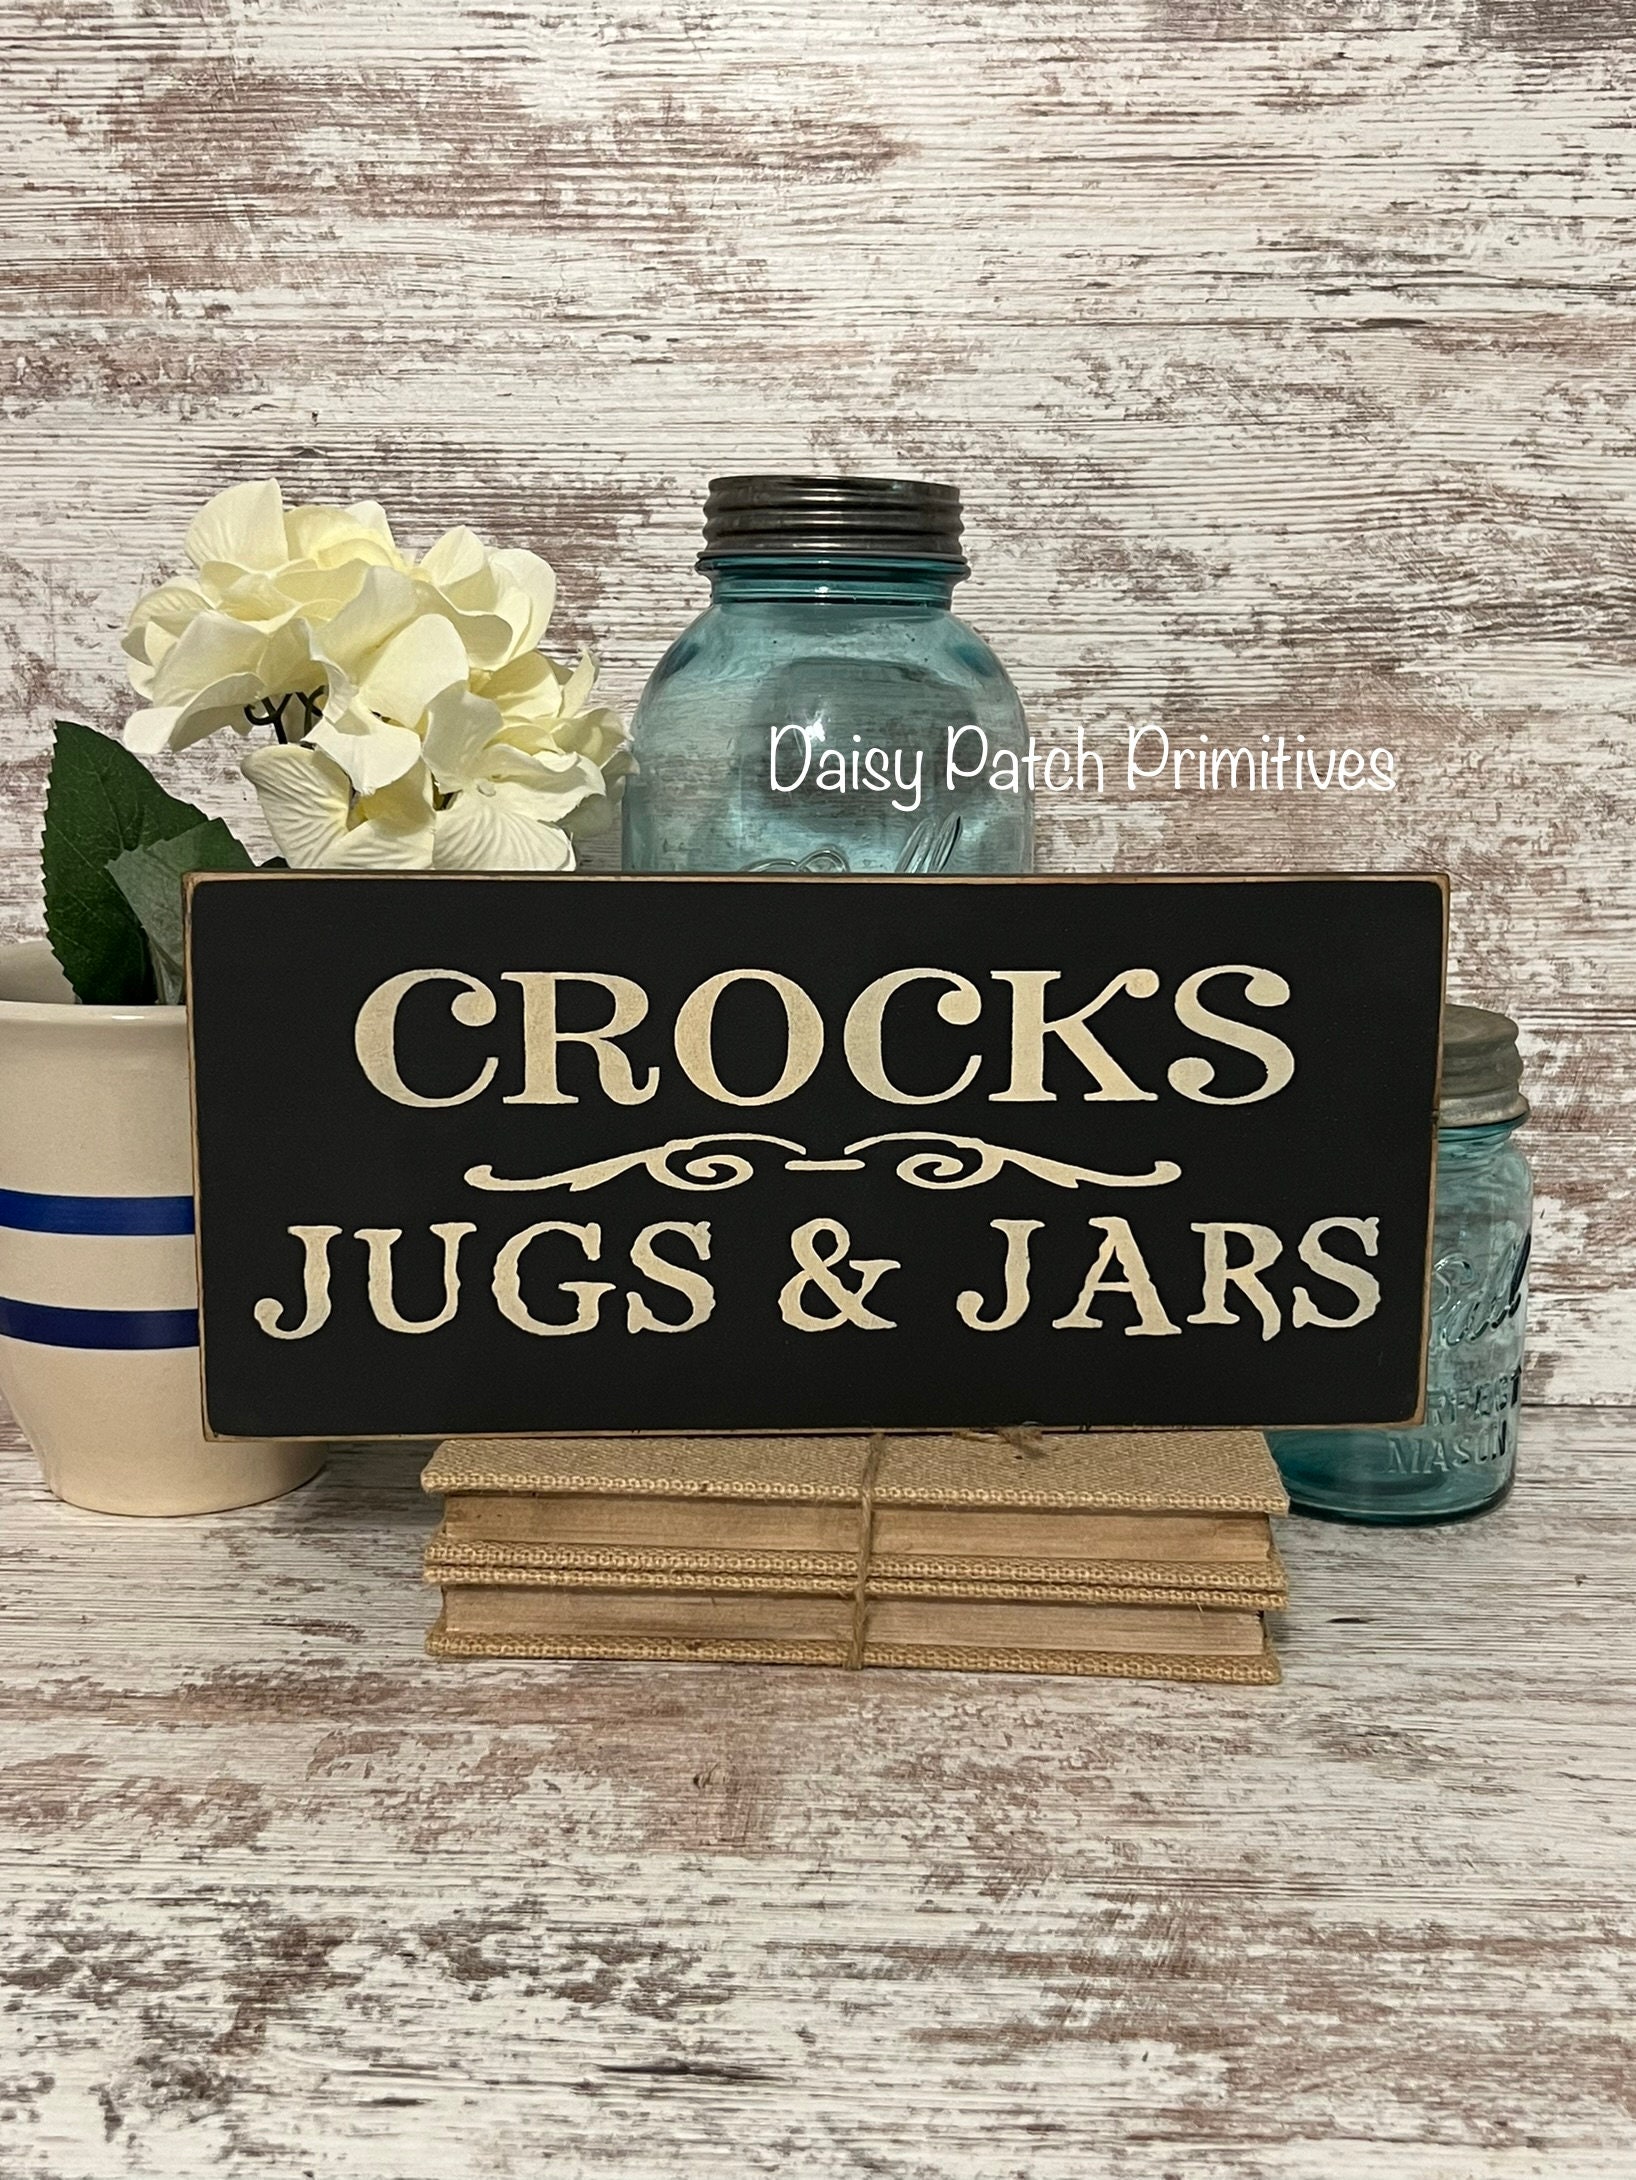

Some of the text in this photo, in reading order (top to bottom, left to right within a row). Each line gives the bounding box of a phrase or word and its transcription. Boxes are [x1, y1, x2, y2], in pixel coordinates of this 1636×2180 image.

[354, 966, 1295, 1107] CROCKS
[254, 1216, 1381, 1342] JUGS & JARS
[1386, 1419, 1508, 1474] MASON
